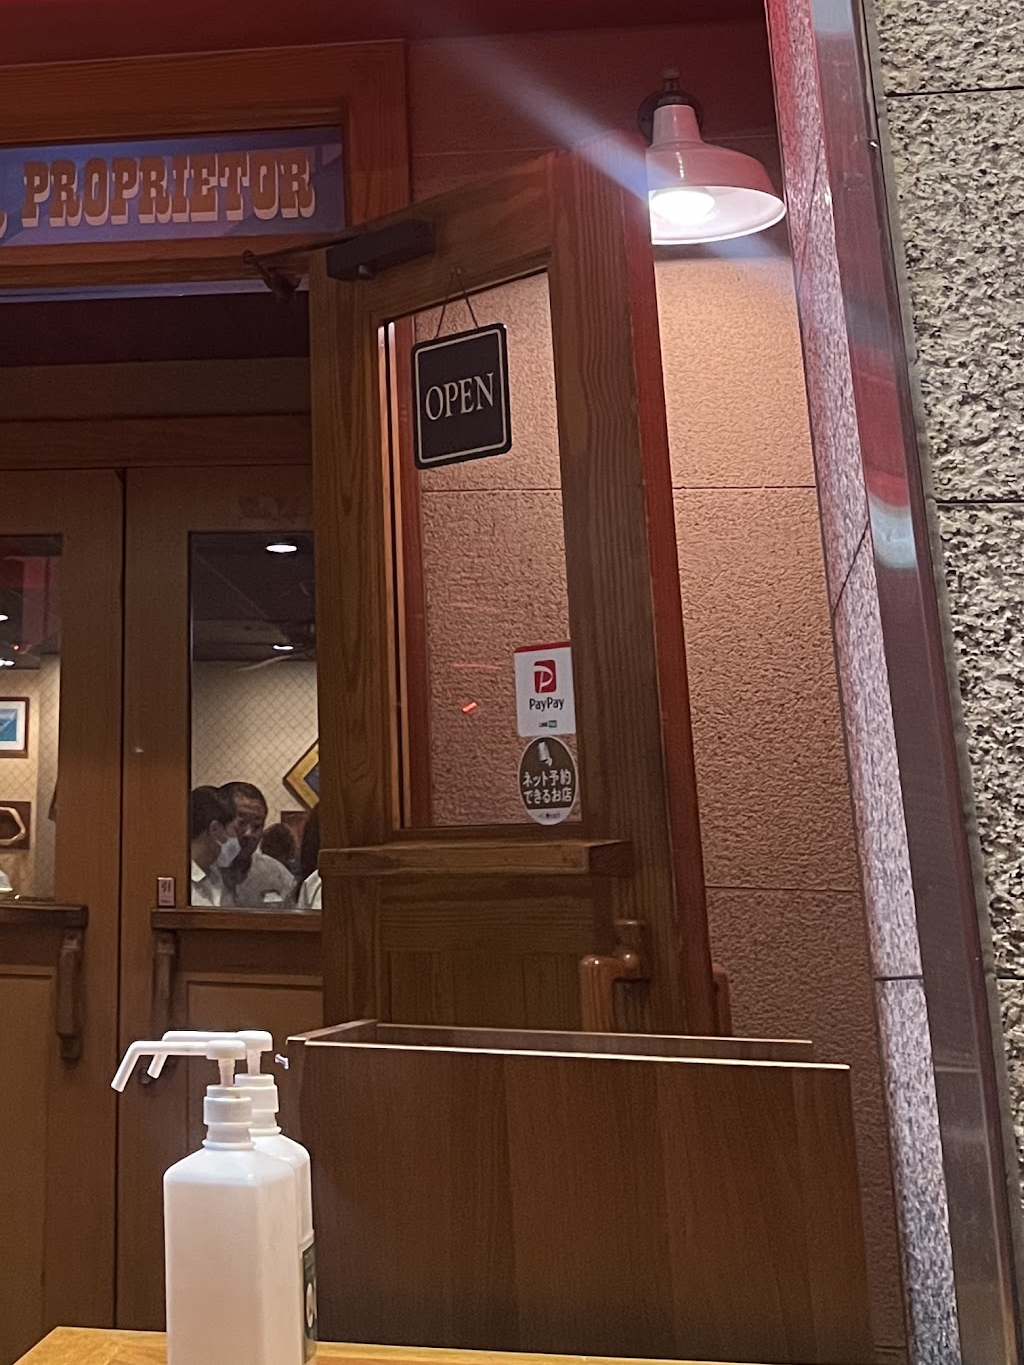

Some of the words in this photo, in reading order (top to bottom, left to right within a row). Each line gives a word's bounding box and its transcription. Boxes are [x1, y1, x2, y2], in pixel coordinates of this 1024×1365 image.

[22, 150, 316, 228] PROPRIETOR
[425, 372, 494, 421] OPEN
[529, 696, 565, 713] PayPay
[522, 768, 572, 788] ネット予約
[523, 787, 573, 805] できるお店
